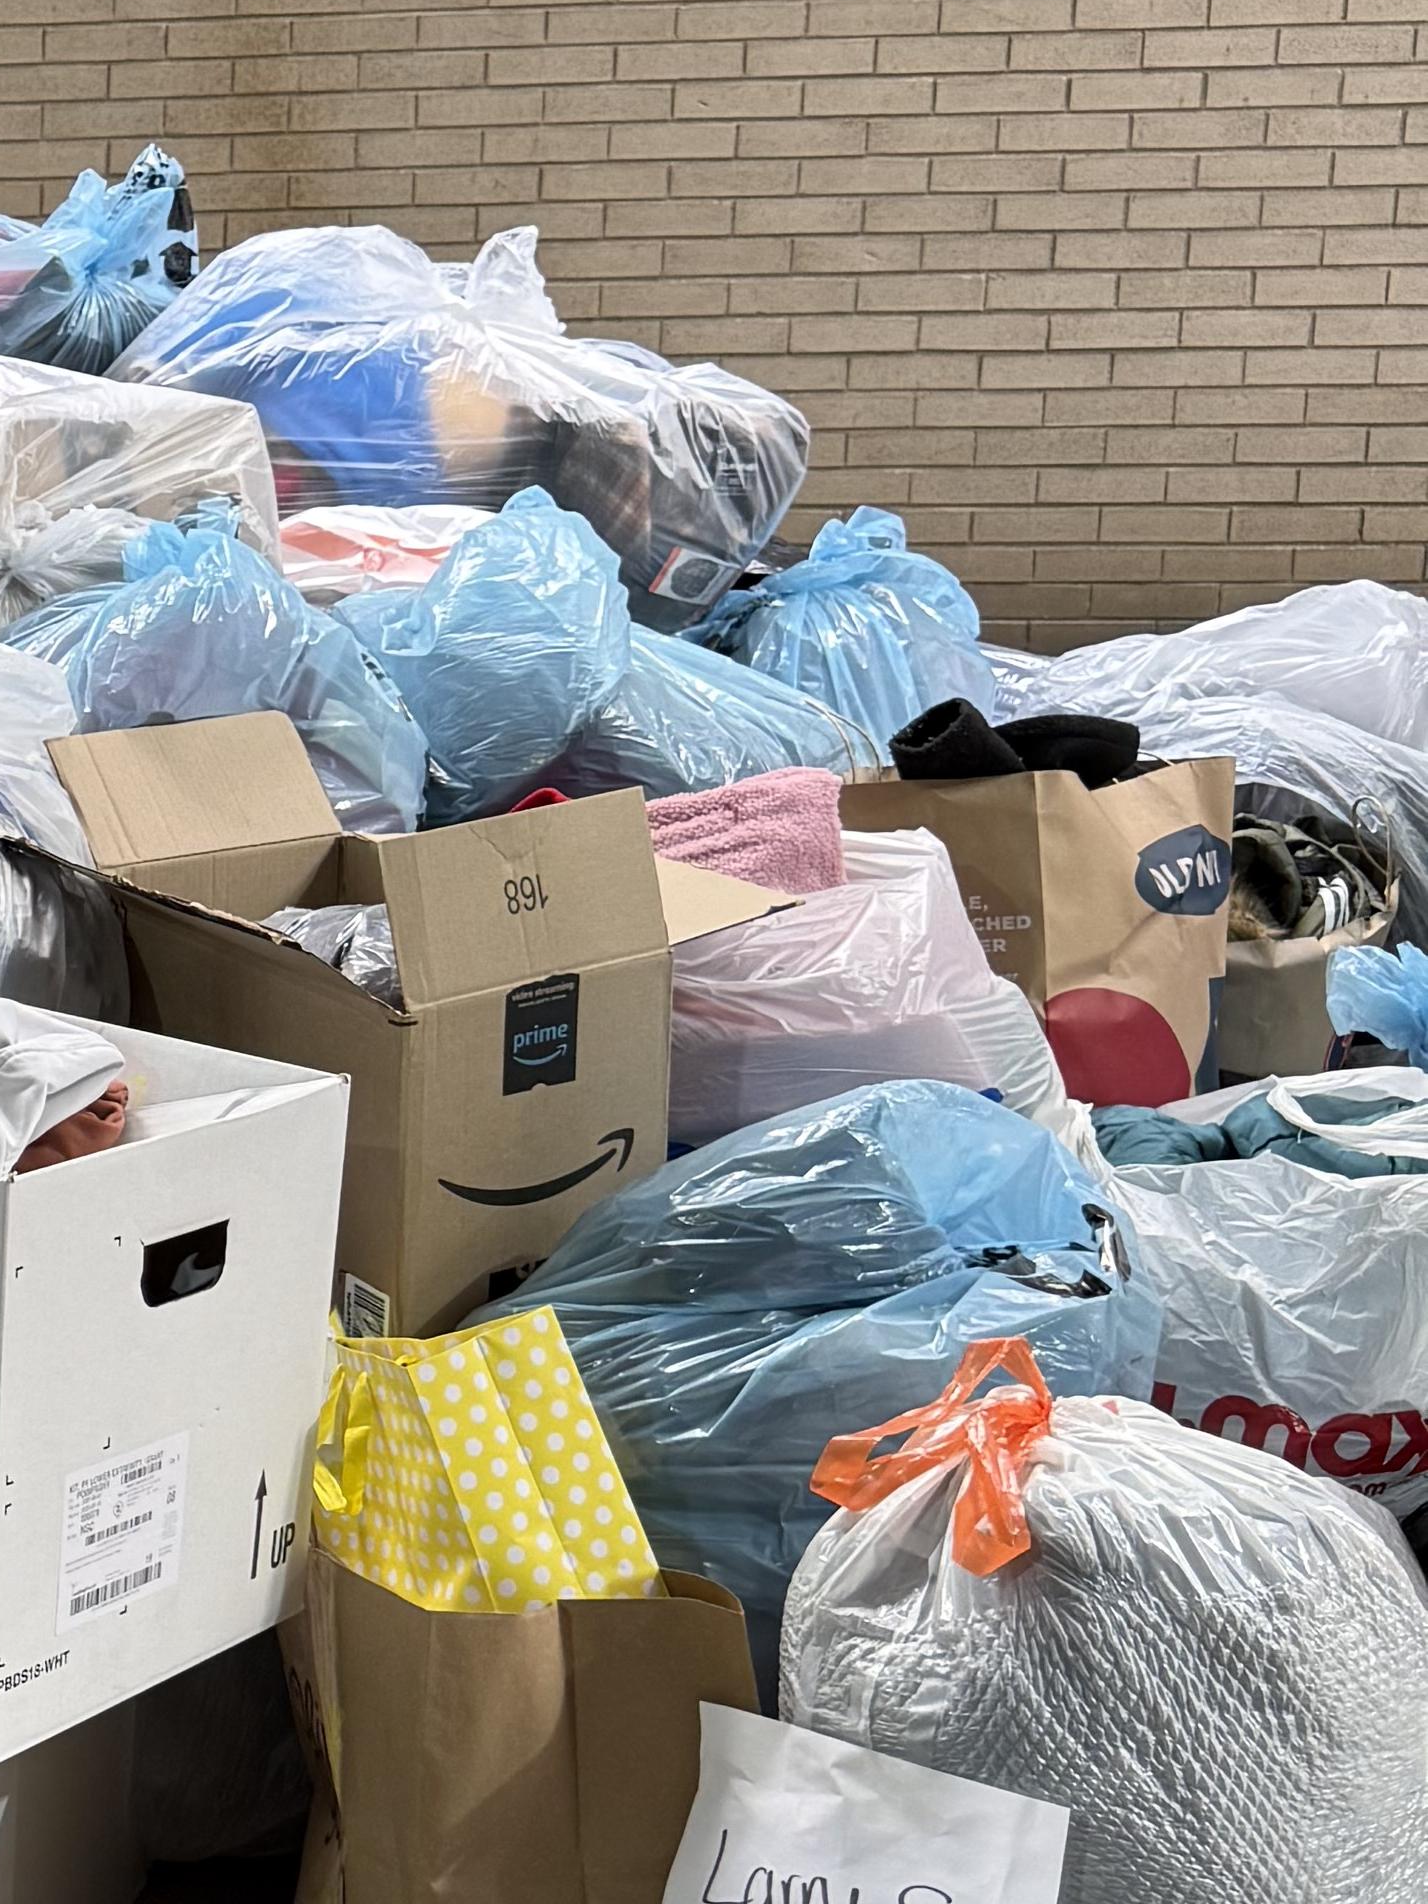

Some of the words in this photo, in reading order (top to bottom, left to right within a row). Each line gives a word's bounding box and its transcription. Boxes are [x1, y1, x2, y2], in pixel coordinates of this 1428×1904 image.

[504, 874, 548, 914] 168
[513, 1024, 568, 1054] prime
[271, 1522, 295, 1569] UP
